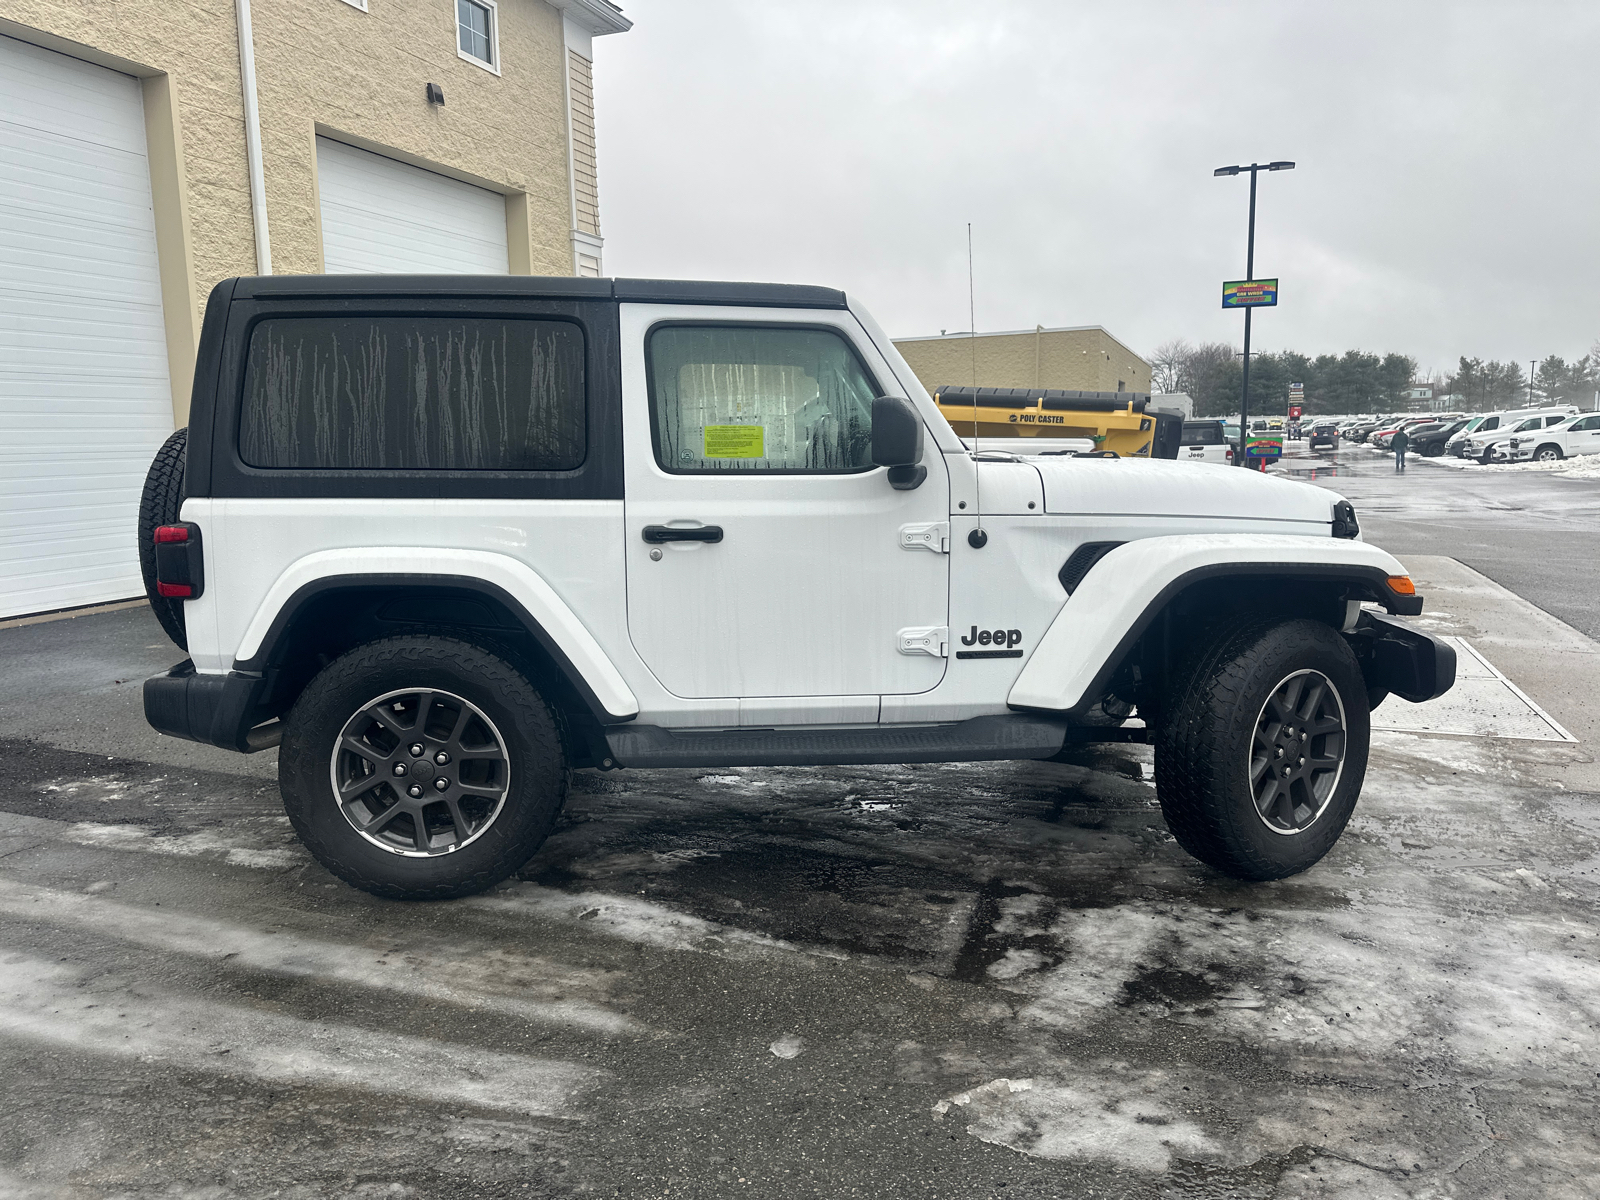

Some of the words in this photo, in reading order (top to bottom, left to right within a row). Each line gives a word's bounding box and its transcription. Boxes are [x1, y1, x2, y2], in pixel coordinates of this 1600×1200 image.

[1020, 414, 1036, 422] POLY
[1038, 415, 1064, 424] CASTER
[961, 625, 1022, 648] Jeep
